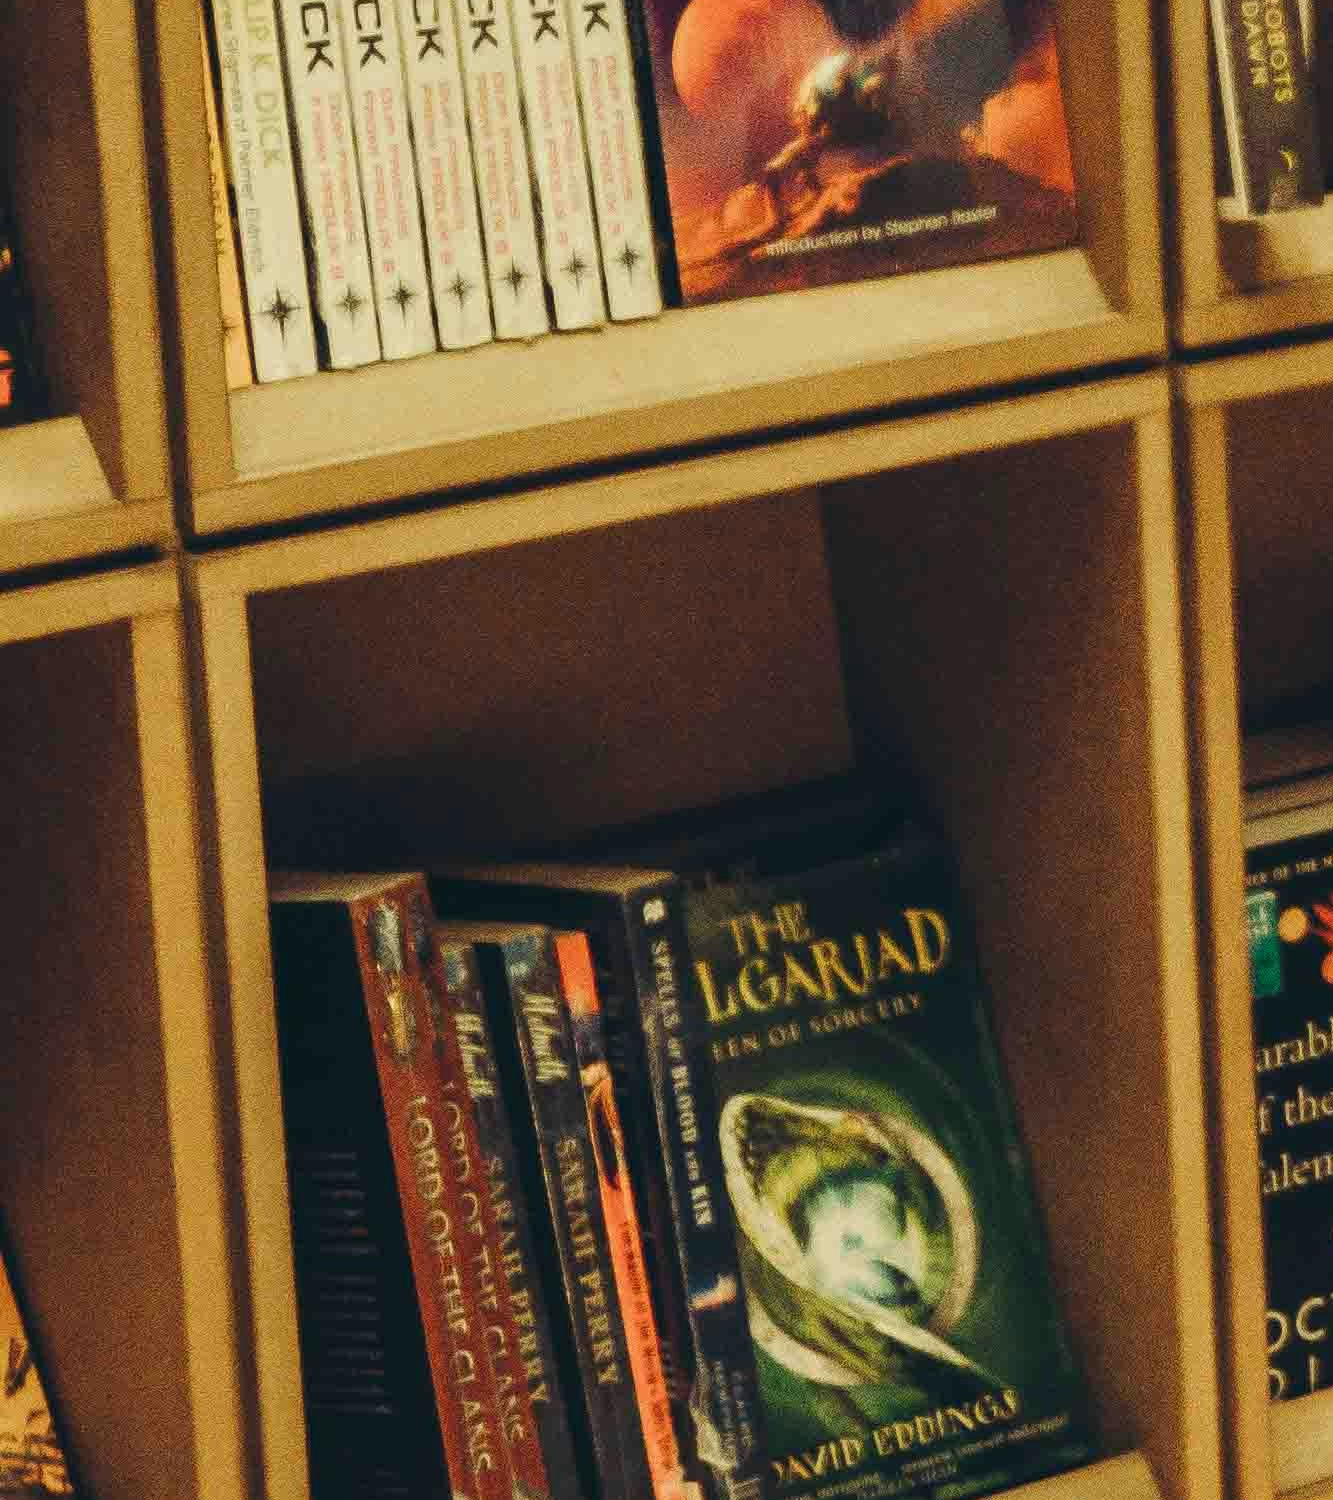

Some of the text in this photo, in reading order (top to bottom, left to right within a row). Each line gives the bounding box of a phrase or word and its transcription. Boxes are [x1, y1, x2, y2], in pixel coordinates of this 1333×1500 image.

[1237, 0, 1270, 87] DAWN
[693, 907, 951, 1023] LGARIAD
[718, 901, 813, 956] THE
[768, 1019, 802, 1048] OF
[809, 991, 923, 1034] SORCERY
[522, 992, 620, 1386] Melmoth SARAH PERRY
[405, 1094, 496, 1473] LORD OF THE CLANS
[483, 1154, 526, 1279] SARAH
[505, 1288, 549, 1406] PERRY
[872, 1387, 1023, 1456] EDDINGS
